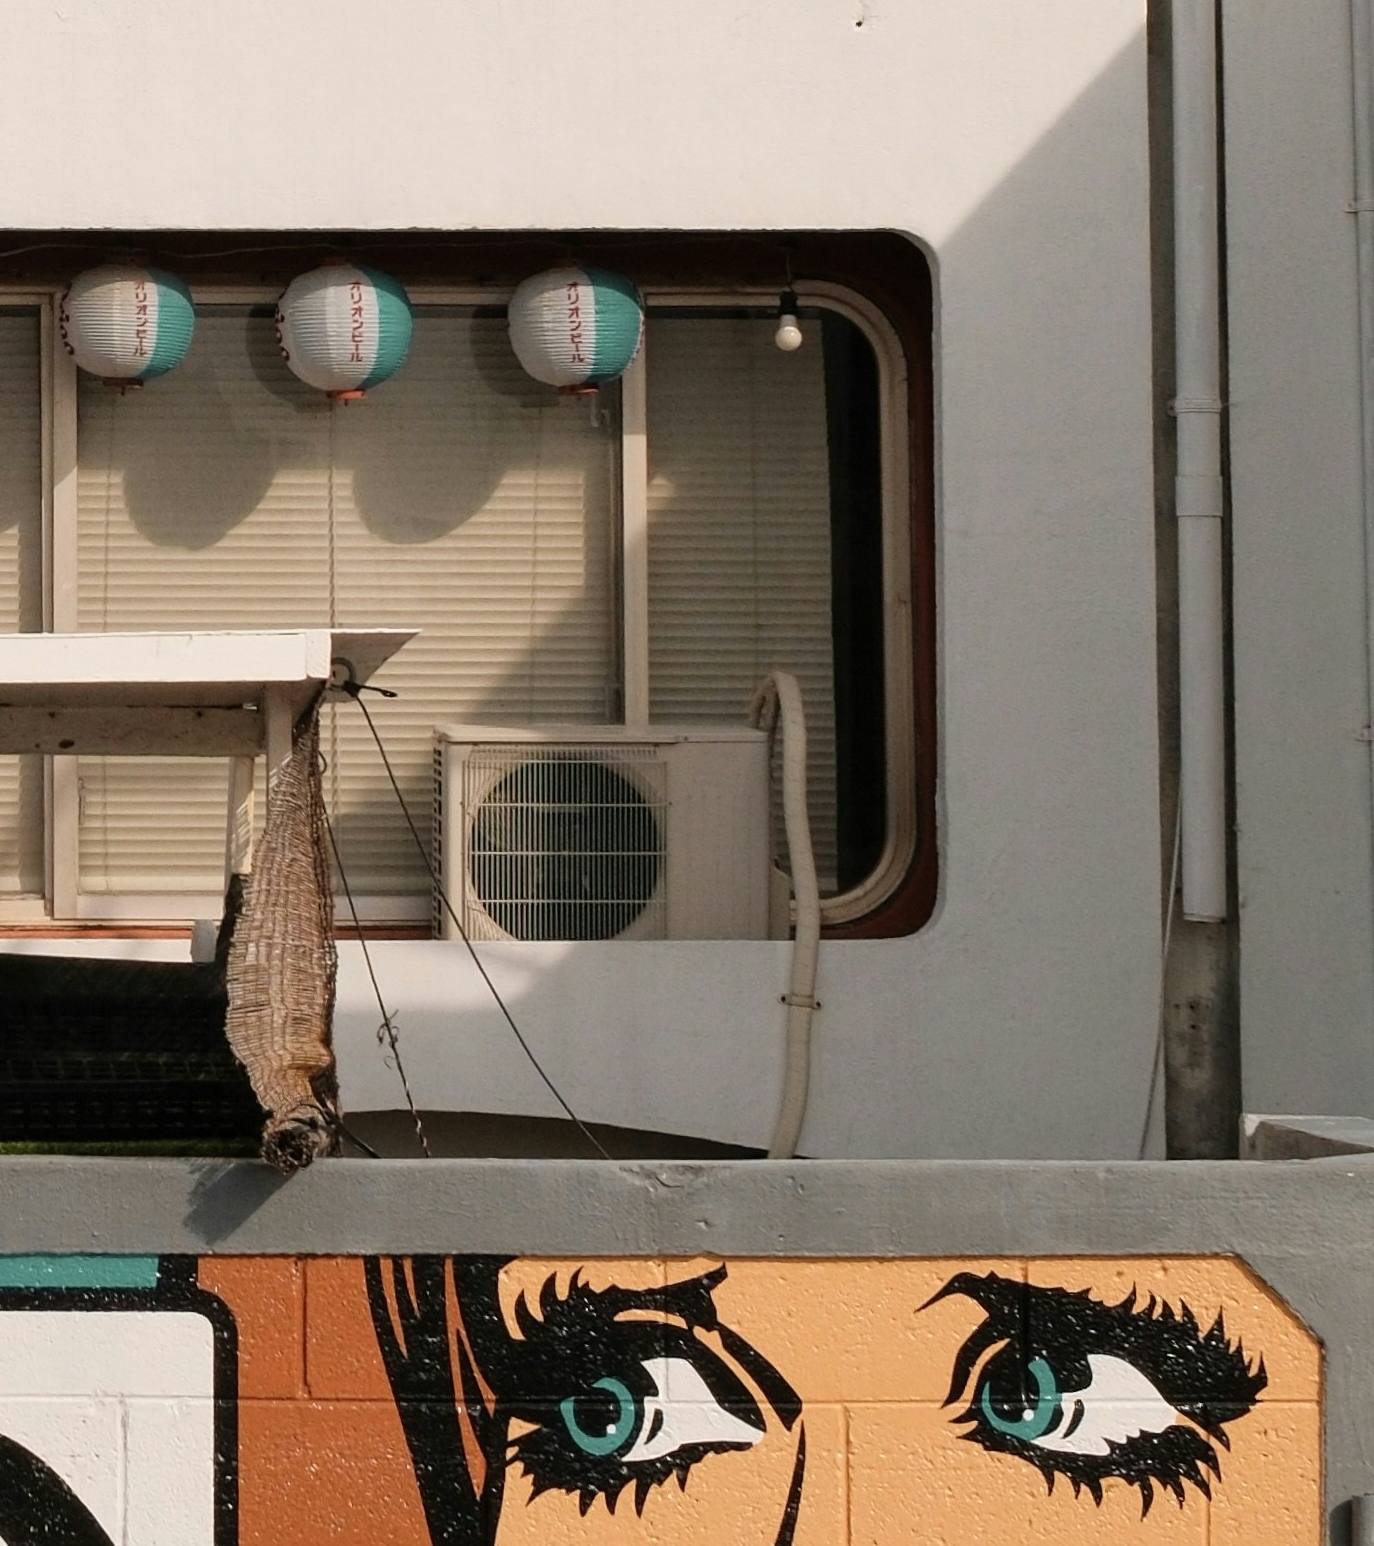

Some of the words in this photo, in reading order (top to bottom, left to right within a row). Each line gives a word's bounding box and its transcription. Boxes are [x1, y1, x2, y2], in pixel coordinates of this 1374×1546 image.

[133, 279, 148, 357] オリオンビール
[348, 280, 364, 363] オリオンビール
[566, 281, 585, 364] オリオンビール
